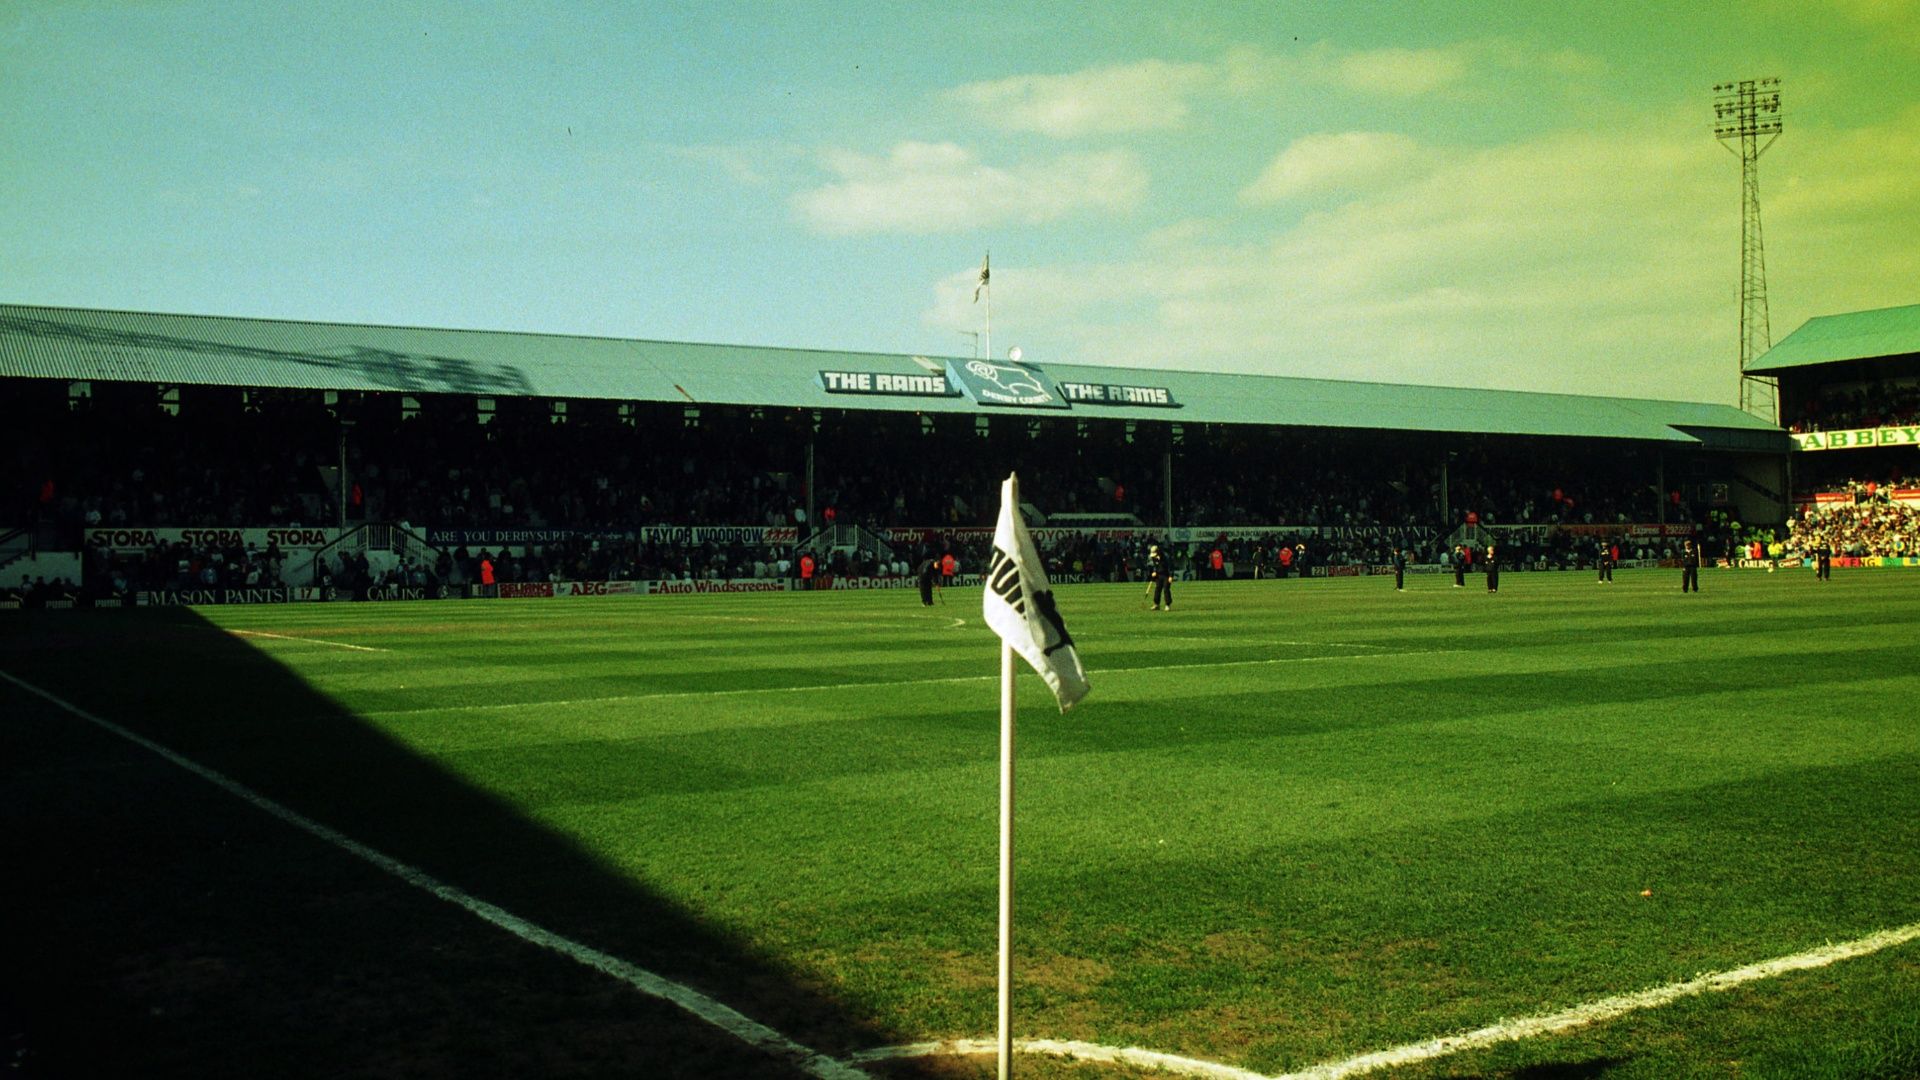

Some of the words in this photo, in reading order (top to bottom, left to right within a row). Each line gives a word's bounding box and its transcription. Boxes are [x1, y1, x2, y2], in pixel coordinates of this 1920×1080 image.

[825, 372, 871, 390] THE
[876, 374, 945, 393] RAMS
[1064, 383, 1105, 400] THE
[1108, 386, 1168, 404] RAMS
[1804, 427, 1920, 449] ABBEY
[92, 530, 156, 546] STORA
[181, 530, 243, 546] STORA
[267, 530, 326, 545] STORA
[431, 530, 457, 542] ARE
[464, 530, 489, 542] YOU
[696, 528, 763, 543] WOODROW
[1334, 526, 1381, 539] MASON
[1738, 558, 1773, 568] CARLING
[570, 582, 607, 596] AEG
[658, 581, 692, 593] Auto
[693, 580, 777, 593] Windscreens
[150, 590, 216, 606] MASON
[225, 588, 284, 604] PAINTS
